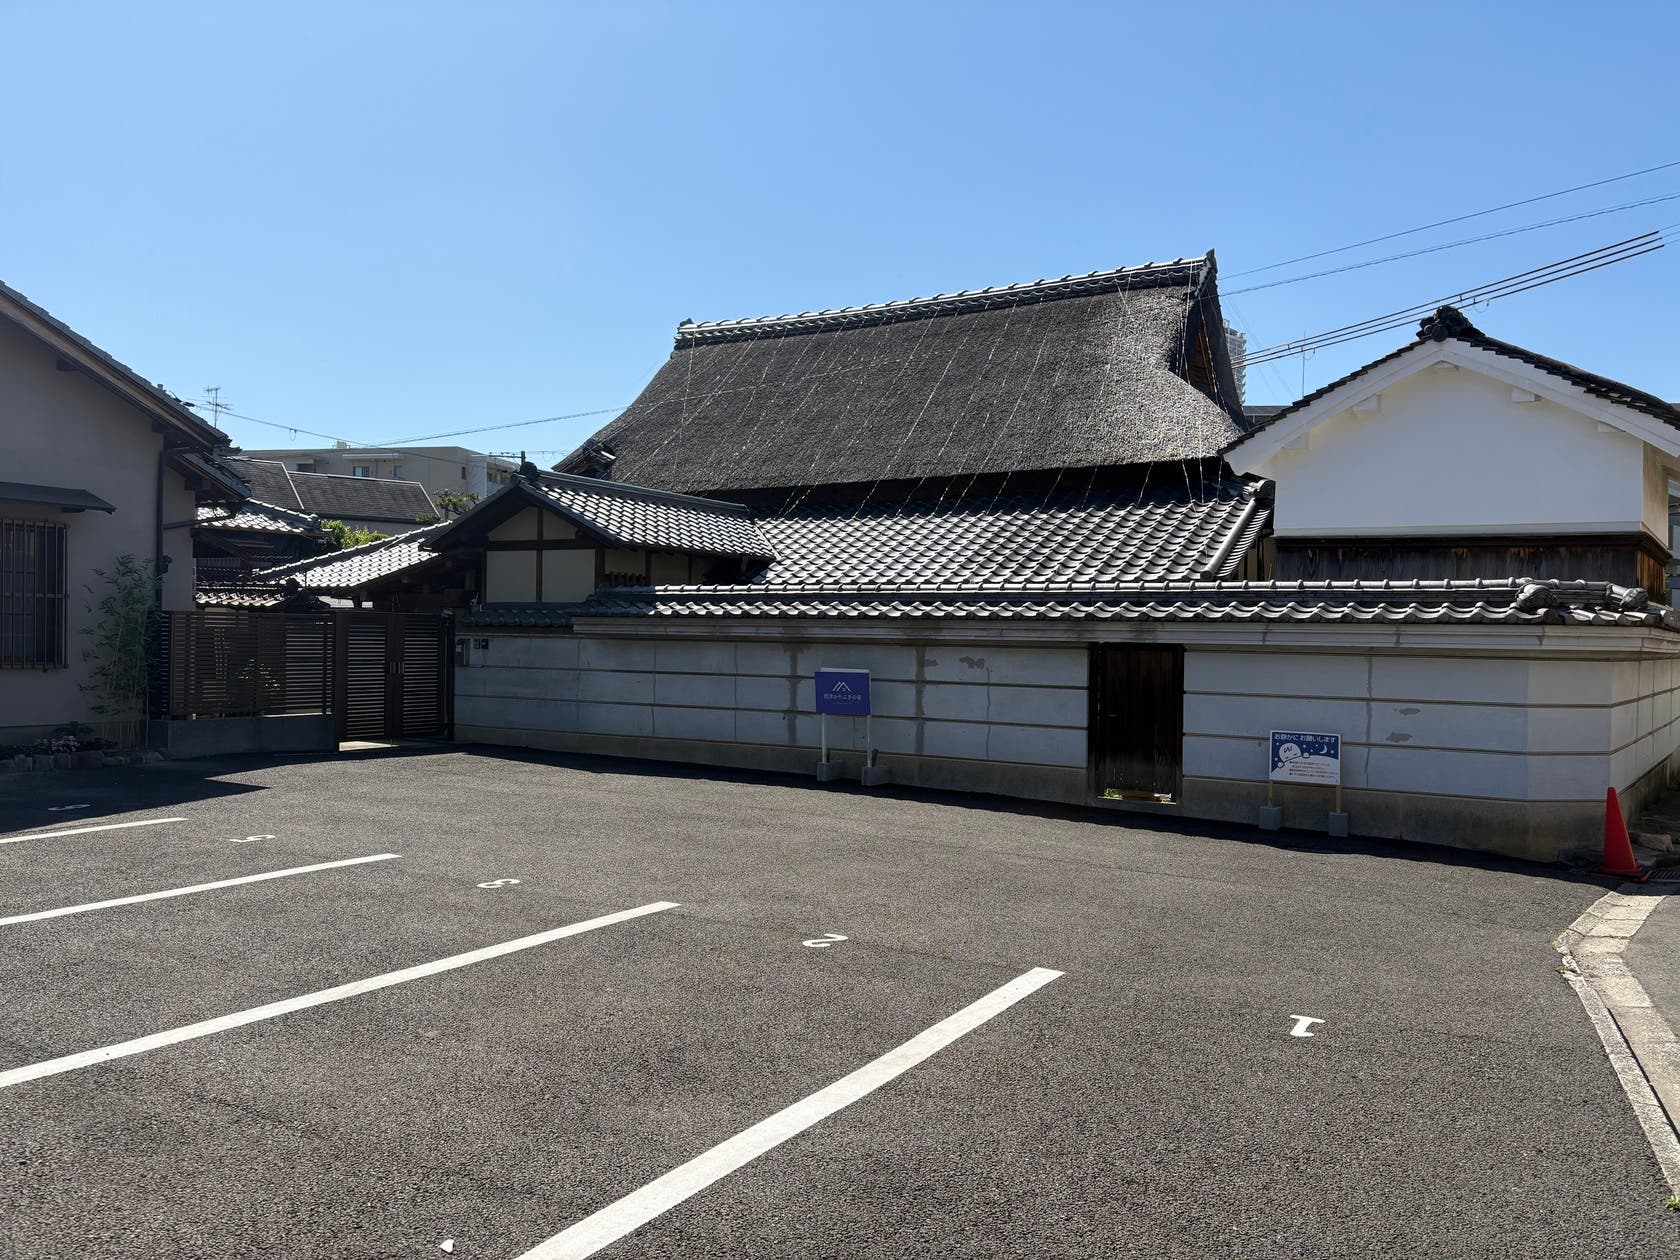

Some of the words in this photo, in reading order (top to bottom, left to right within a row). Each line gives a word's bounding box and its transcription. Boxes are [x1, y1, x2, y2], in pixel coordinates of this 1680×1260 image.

[476, 878, 521, 889] 3
[802, 933, 849, 948] 2
[1289, 1014, 1326, 1037] 1
